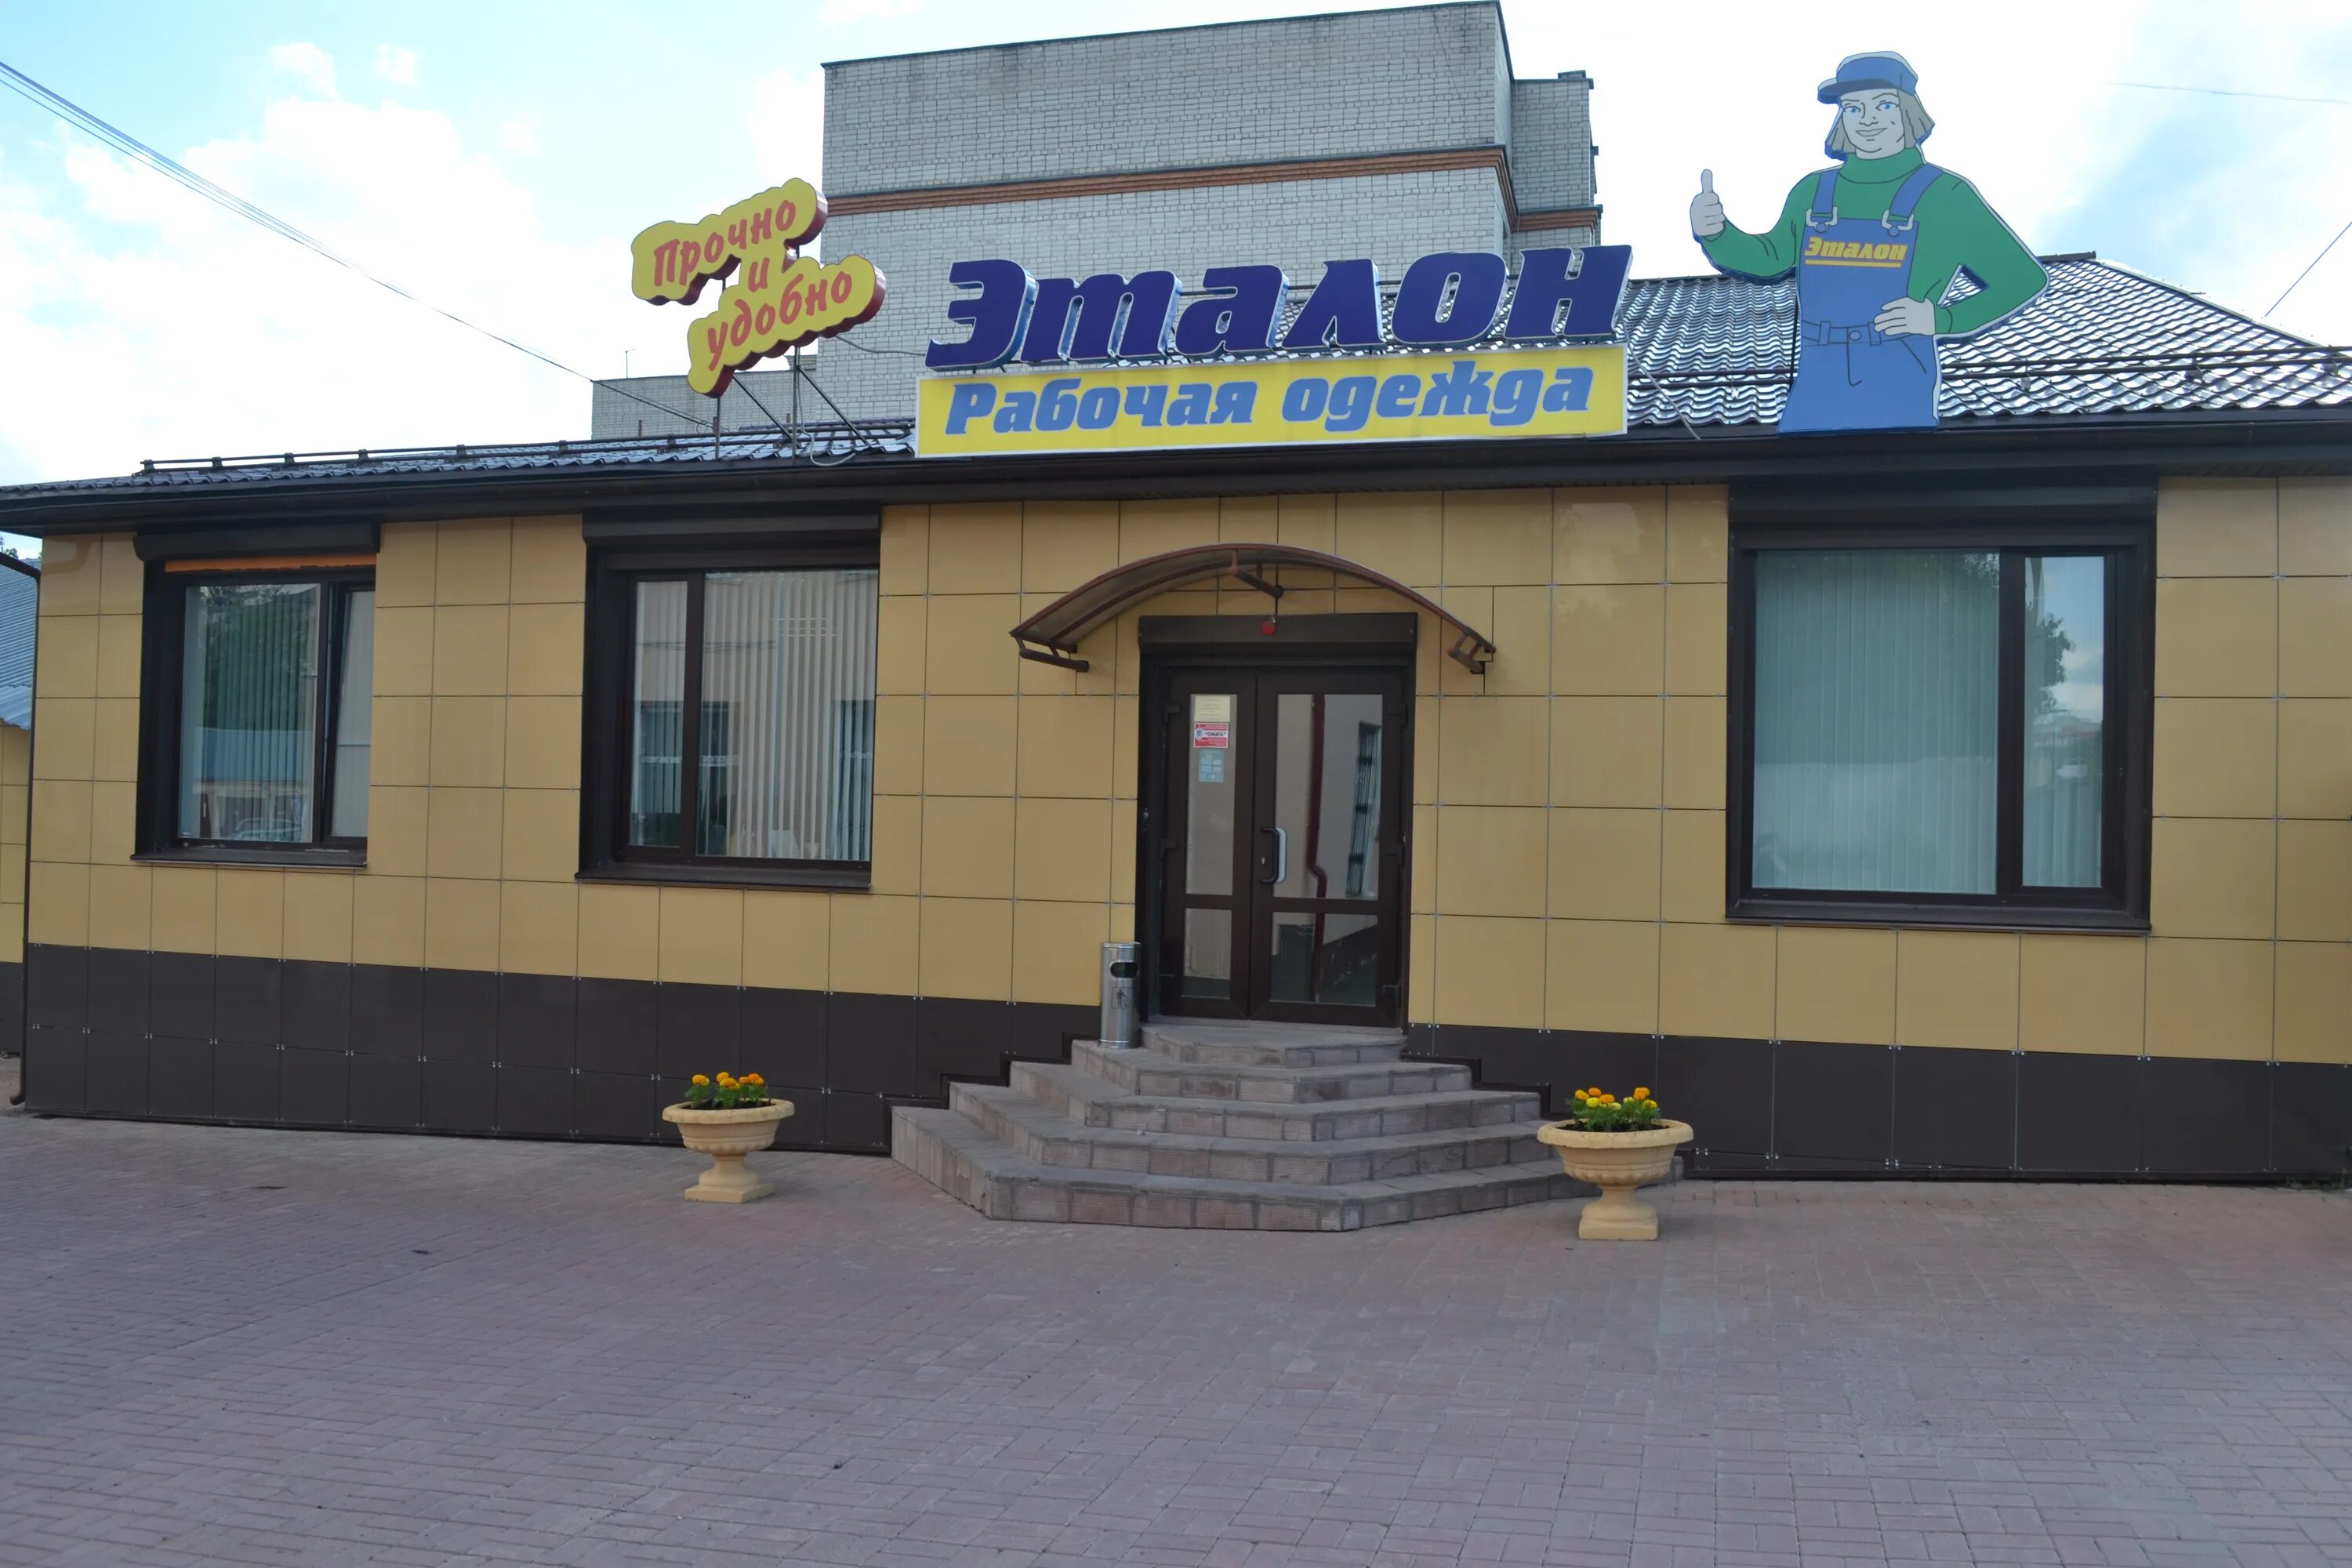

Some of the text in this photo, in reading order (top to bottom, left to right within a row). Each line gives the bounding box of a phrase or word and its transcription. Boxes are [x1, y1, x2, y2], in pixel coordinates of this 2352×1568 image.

[654, 200, 796, 287] Прочно
[748, 257, 770, 292] и
[1805, 236, 1907, 260] Эталон
[707, 270, 852, 372] удобно
[925, 245, 1633, 369] Эталон
[946, 361, 1594, 435] Рабочая одежда
